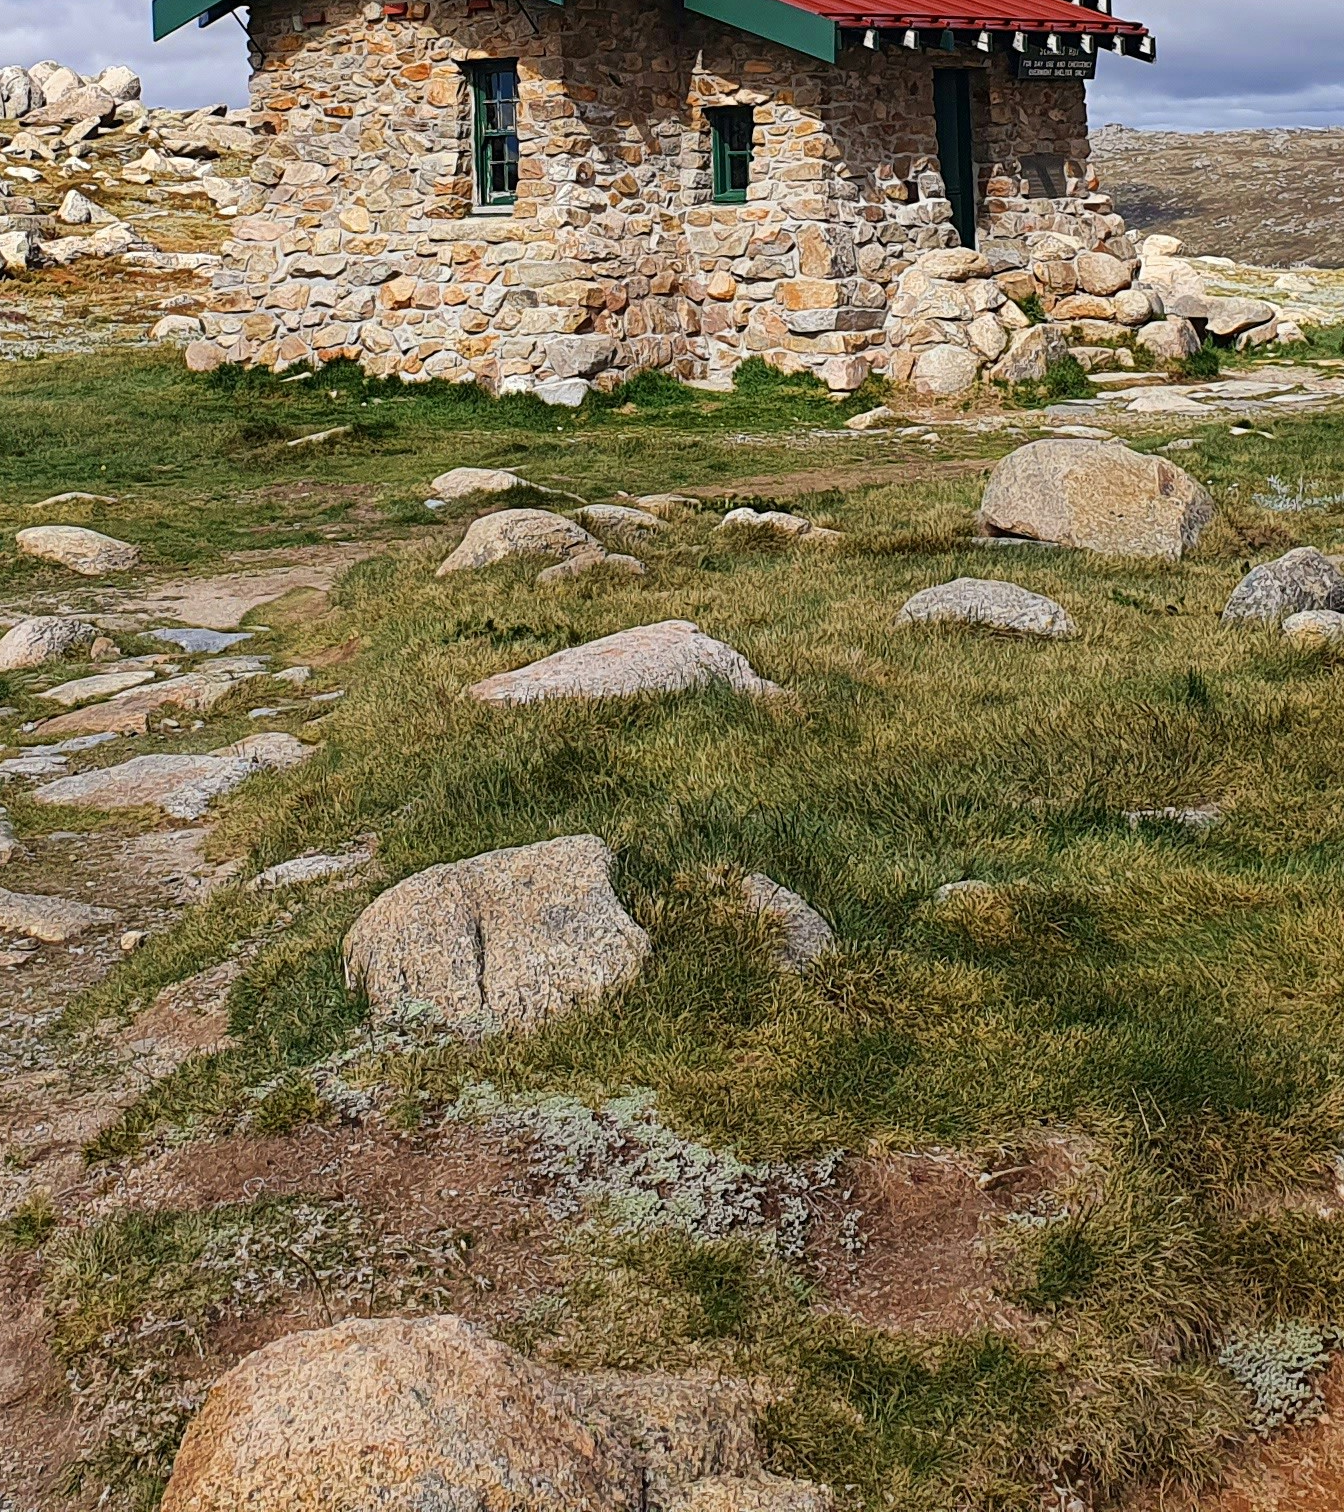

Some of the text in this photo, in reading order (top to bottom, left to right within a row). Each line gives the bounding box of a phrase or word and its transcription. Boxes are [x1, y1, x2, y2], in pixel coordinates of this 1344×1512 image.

[1034, 60, 1044, 68] DAY
[1056, 60, 1066, 68] AND
[1074, 69, 1087, 77] ONLY
